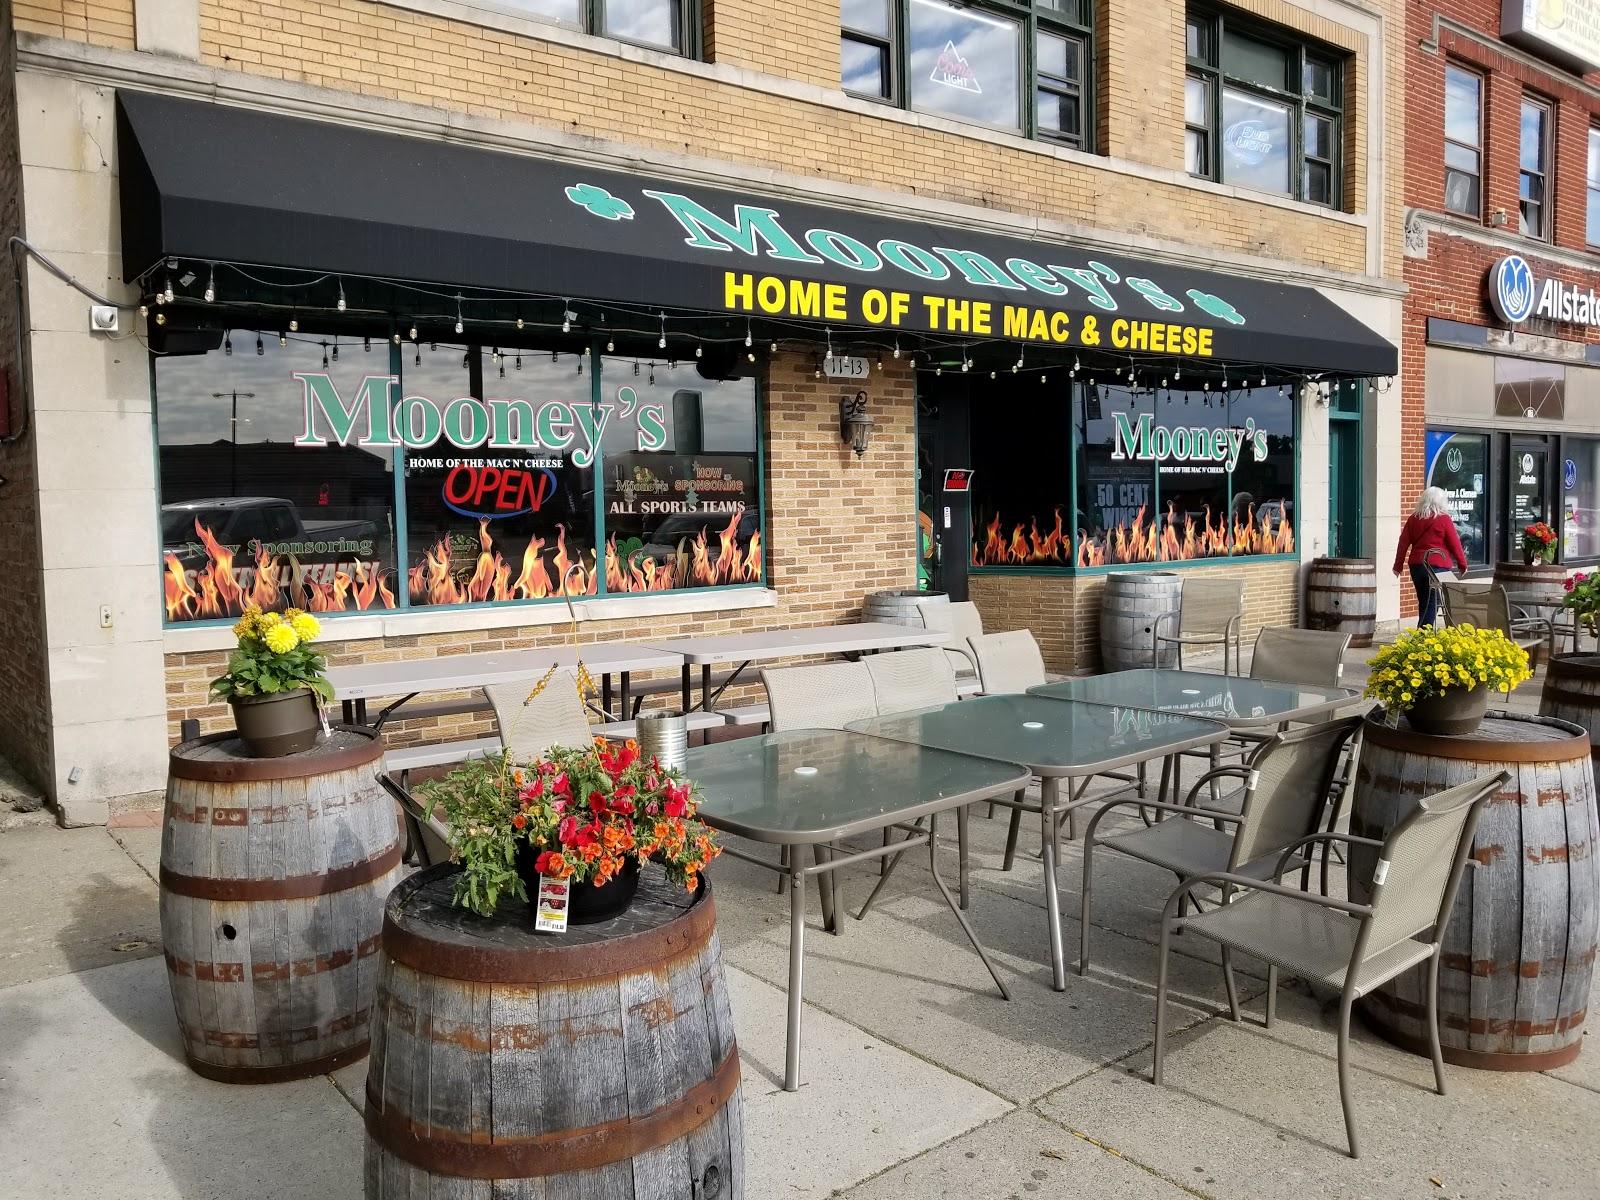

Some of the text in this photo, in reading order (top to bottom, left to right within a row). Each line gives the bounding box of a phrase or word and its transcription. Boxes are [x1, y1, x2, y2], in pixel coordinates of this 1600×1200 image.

[944, 72, 968, 87] LIGHT
[642, 189, 1184, 312] Mooney's
[725, 272, 1213, 356] HOME OF THE MAC & CHEESE
[832, 357, 862, 375] 11-13
[293, 371, 667, 468] Mooney's
[1111, 412, 1268, 473] Mooney's
[409, 458, 444, 468] HOME
[446, 459, 462, 468] OF
[462, 459, 484, 468] THE
[486, 459, 512, 468] MAC
[525, 459, 564, 468] CHEESE
[445, 463, 547, 512] OPEN
[674, 479, 744, 491] SPONSORING
[1120, 484, 1150, 507] CENT
[610, 500, 746, 514] ALL SPORTS TEAMS
